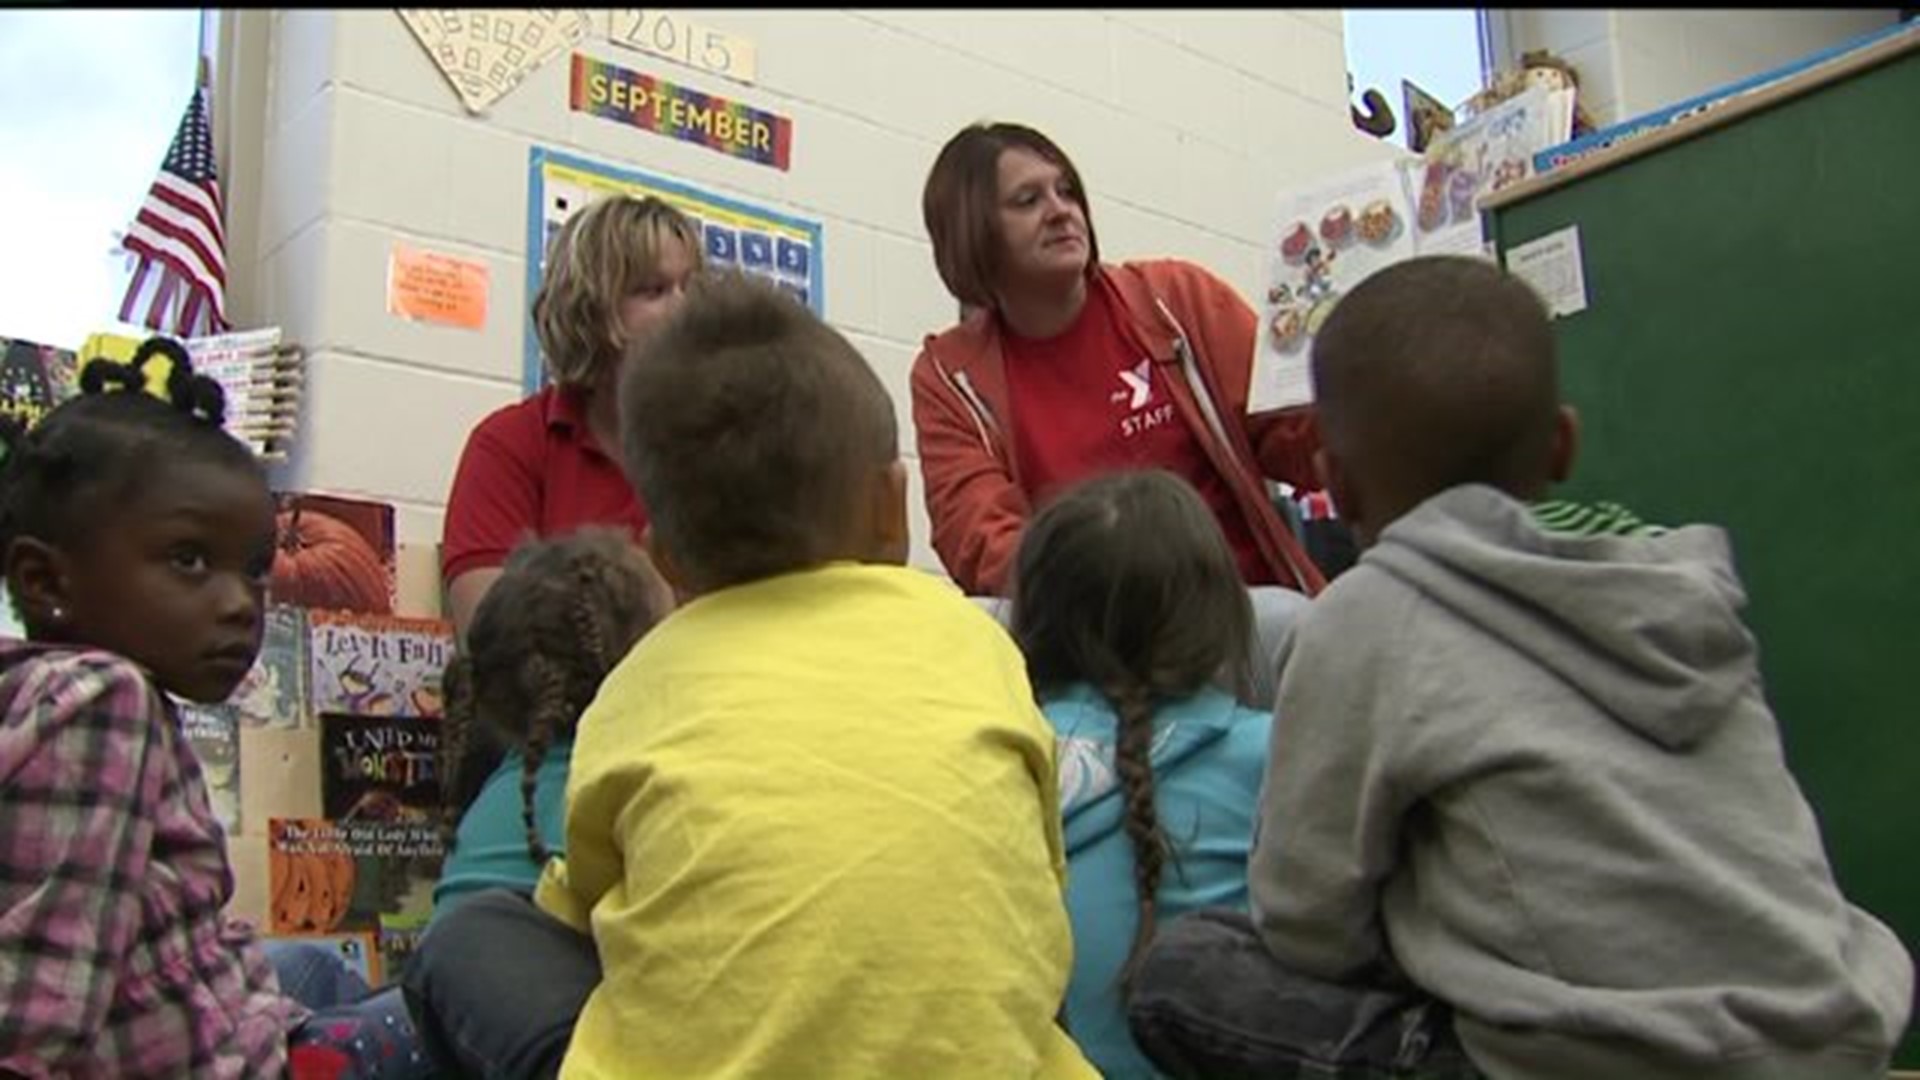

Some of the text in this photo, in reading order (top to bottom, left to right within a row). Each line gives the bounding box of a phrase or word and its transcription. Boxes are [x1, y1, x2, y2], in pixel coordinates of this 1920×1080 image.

[625, 9, 731, 72] 2015
[589, 75, 771, 153] SEPTEMBER
[1121, 403, 1173, 438] STAFF
[371, 635, 391, 660] It
[399, 637, 444, 668] Fall
[286, 825, 309, 840] The
[351, 828, 374, 841] Old
[377, 829, 406, 843] Lady
